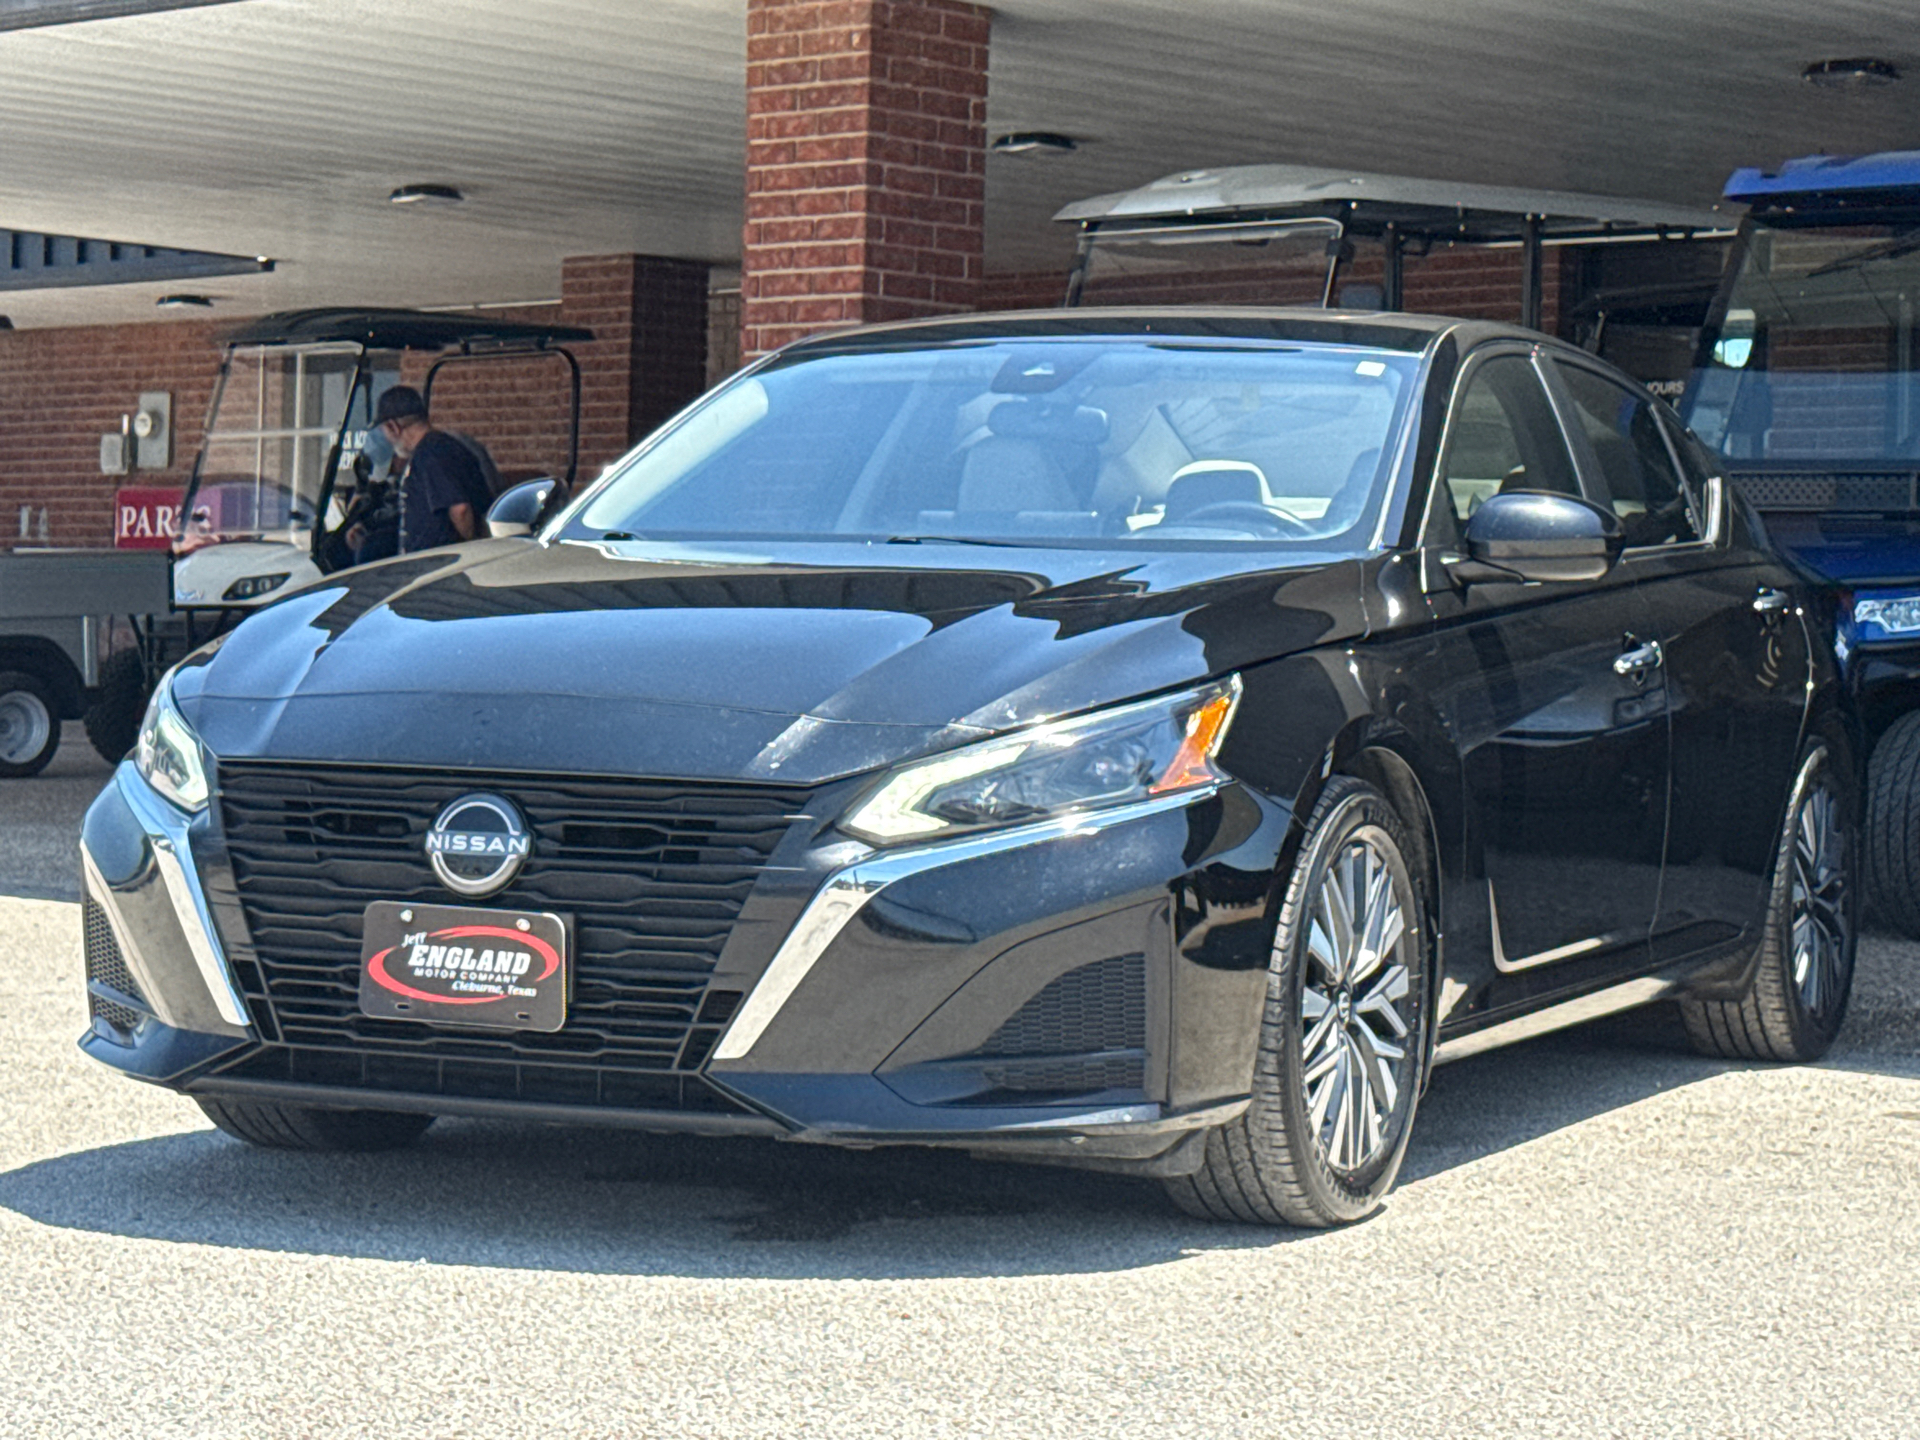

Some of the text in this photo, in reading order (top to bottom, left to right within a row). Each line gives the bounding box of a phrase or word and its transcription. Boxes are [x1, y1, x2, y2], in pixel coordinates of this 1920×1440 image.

[428, 833, 527, 853] NISSAN
[401, 931, 427, 947] Jeff
[408, 945, 531, 975] ENGLAND
[414, 967, 518, 983] MOTOR COMPANY
